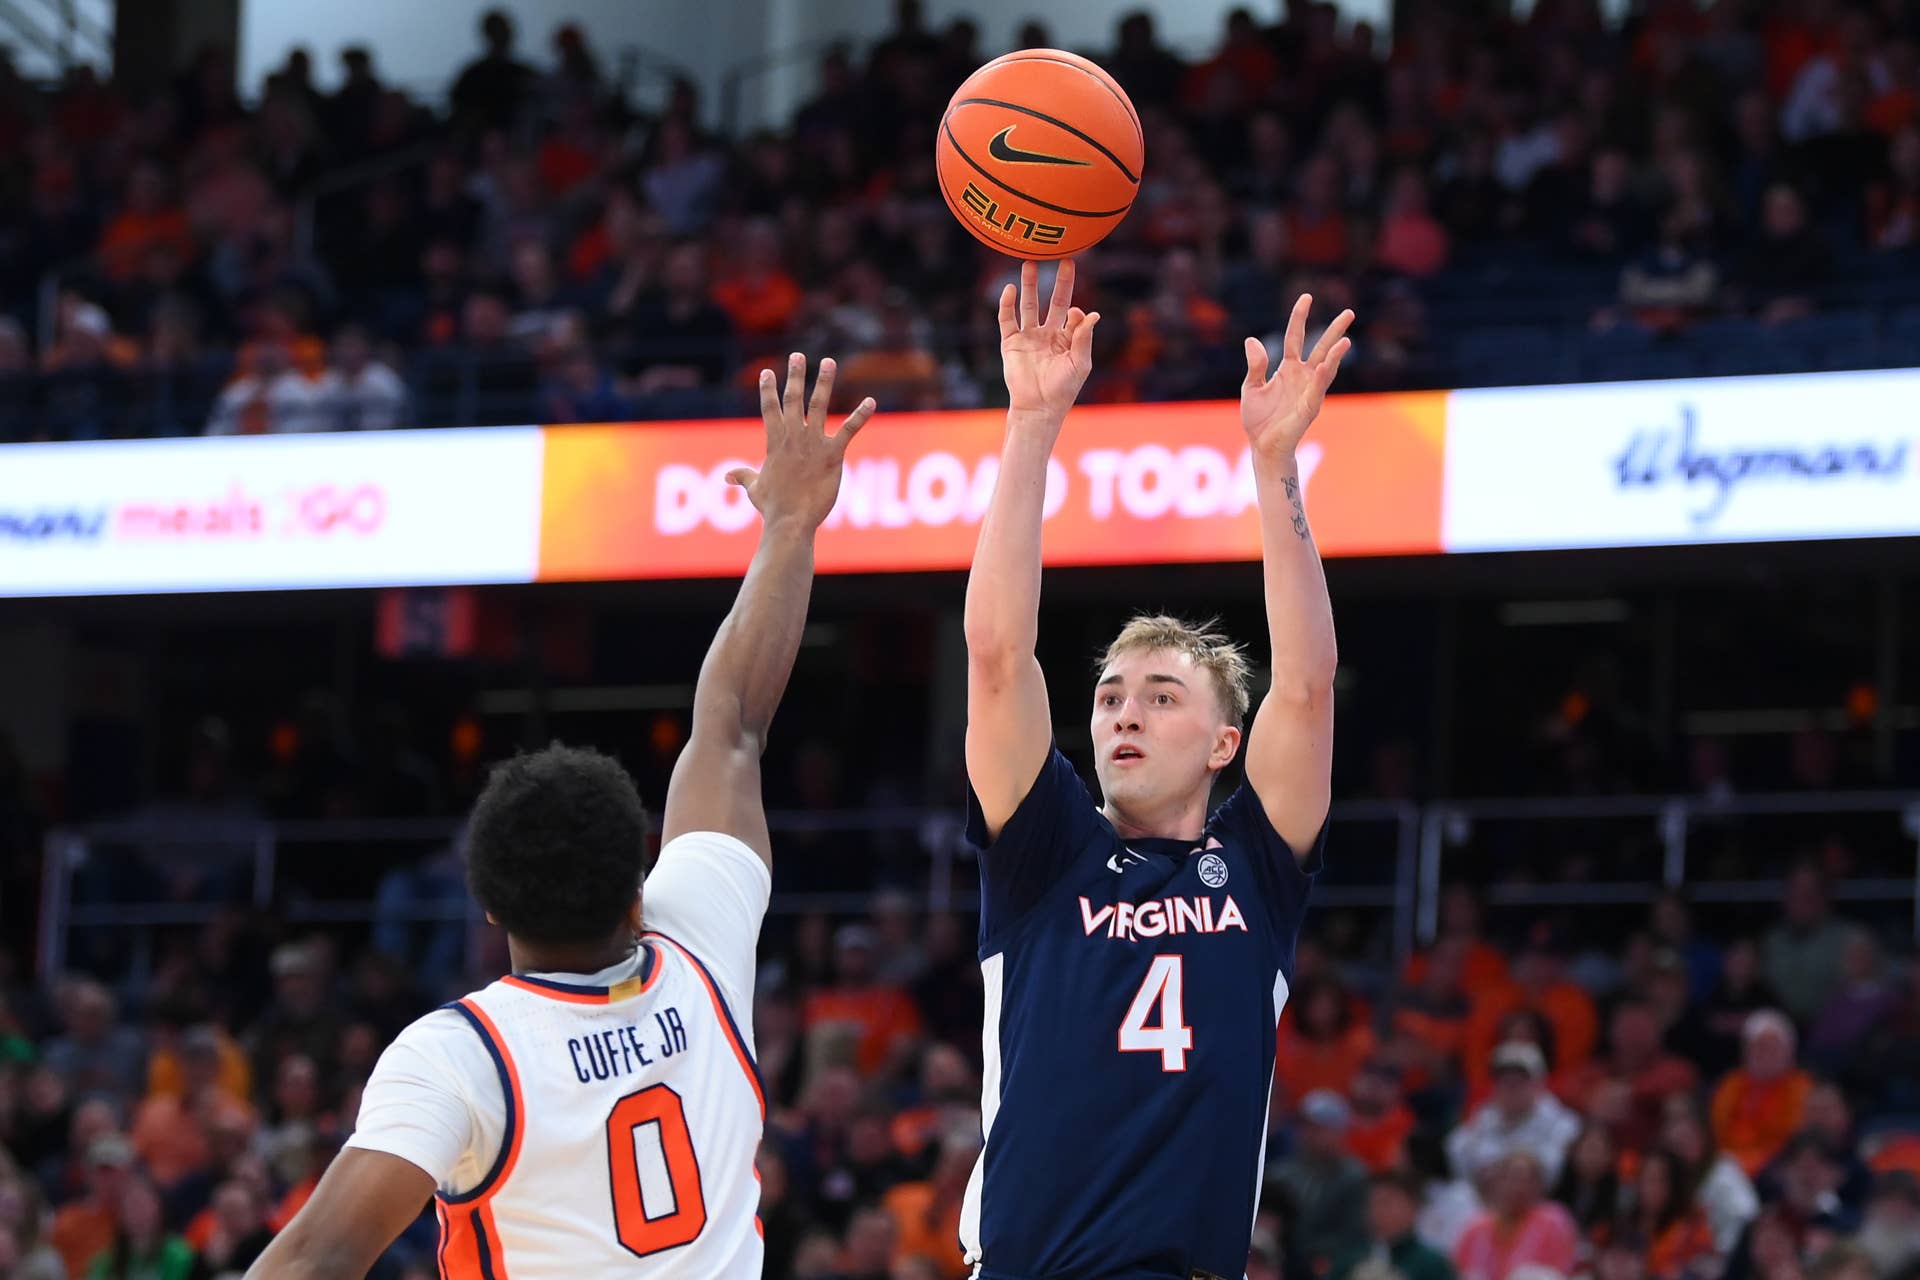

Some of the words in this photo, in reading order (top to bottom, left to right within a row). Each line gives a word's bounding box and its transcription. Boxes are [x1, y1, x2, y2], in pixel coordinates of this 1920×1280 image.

[961, 180, 1067, 246] ELITE
[1078, 894, 1248, 942] VIRGINIA
[567, 1025, 653, 1084] CUFFE
[654, 1006, 688, 1059] JR
[1117, 954, 1193, 1072] 4
[606, 1082, 708, 1258] 0
